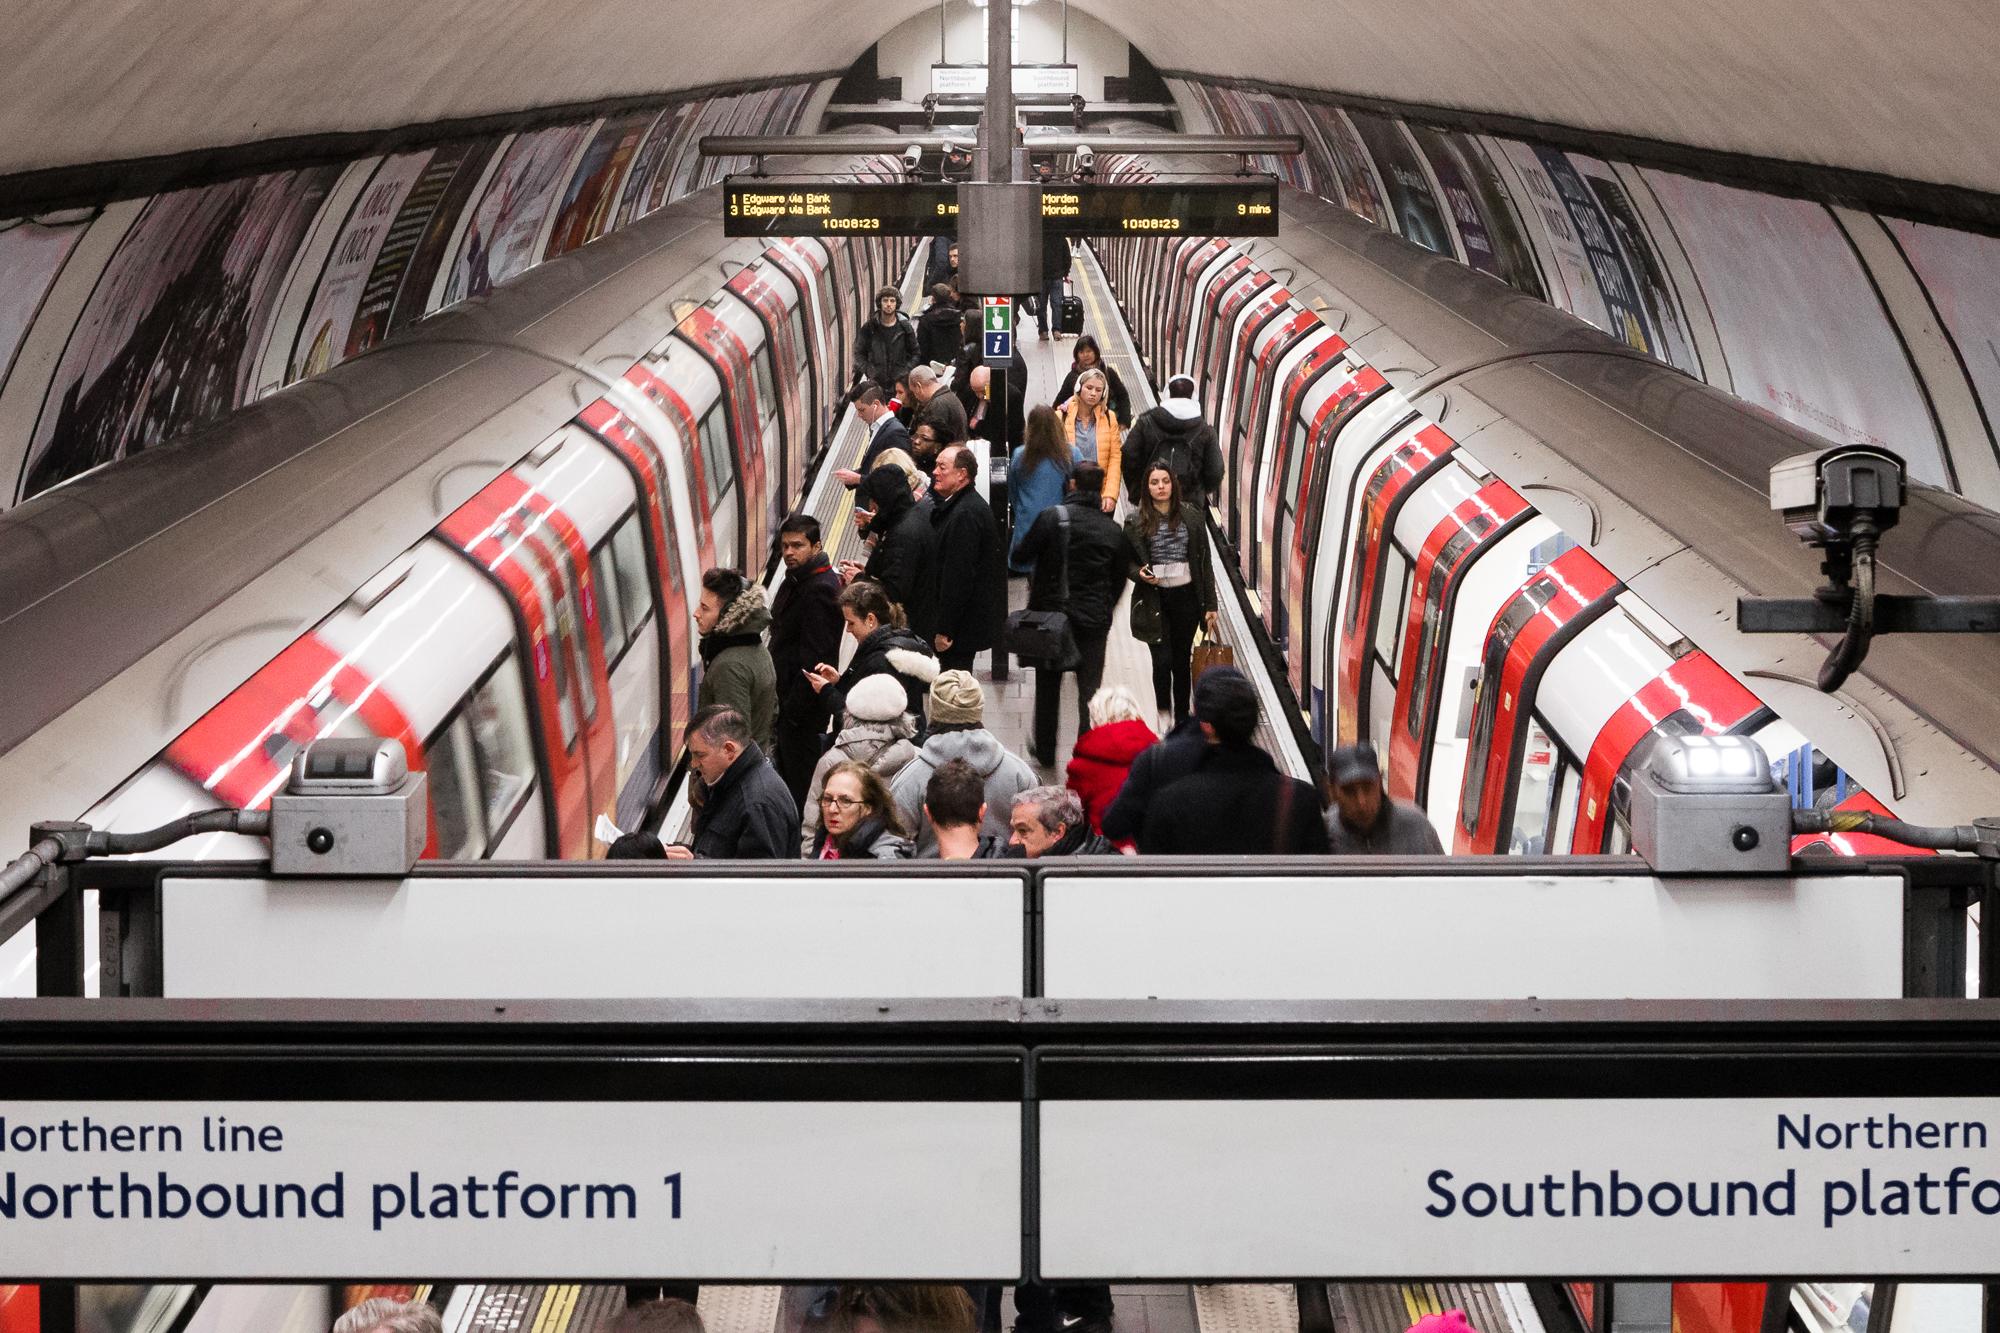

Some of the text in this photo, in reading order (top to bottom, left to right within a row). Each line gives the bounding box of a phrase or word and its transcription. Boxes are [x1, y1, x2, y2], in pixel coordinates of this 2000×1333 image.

[731, 194, 831, 206] 1 Edgware via Bank
[1042, 193, 1079, 204] Morden
[730, 205, 831, 217] 3 Edgware via Bank
[937, 204, 946, 215] 9
[1042, 205, 1079, 215] Morden
[1237, 204, 1272, 215] 9 mins
[823, 218, 880, 229] 10:08:23
[1122, 218, 1180, 229] 10:08:23
[336, 224, 381, 267] KNOCK
[0, 1116, 283, 1153] orthern line
[1778, 1113, 1987, 1150] Northern
[372, 1170, 637, 1231] platform
[664, 1172, 682, 1219] 1
[1425, 1166, 2000, 1229] Southbound platfo
